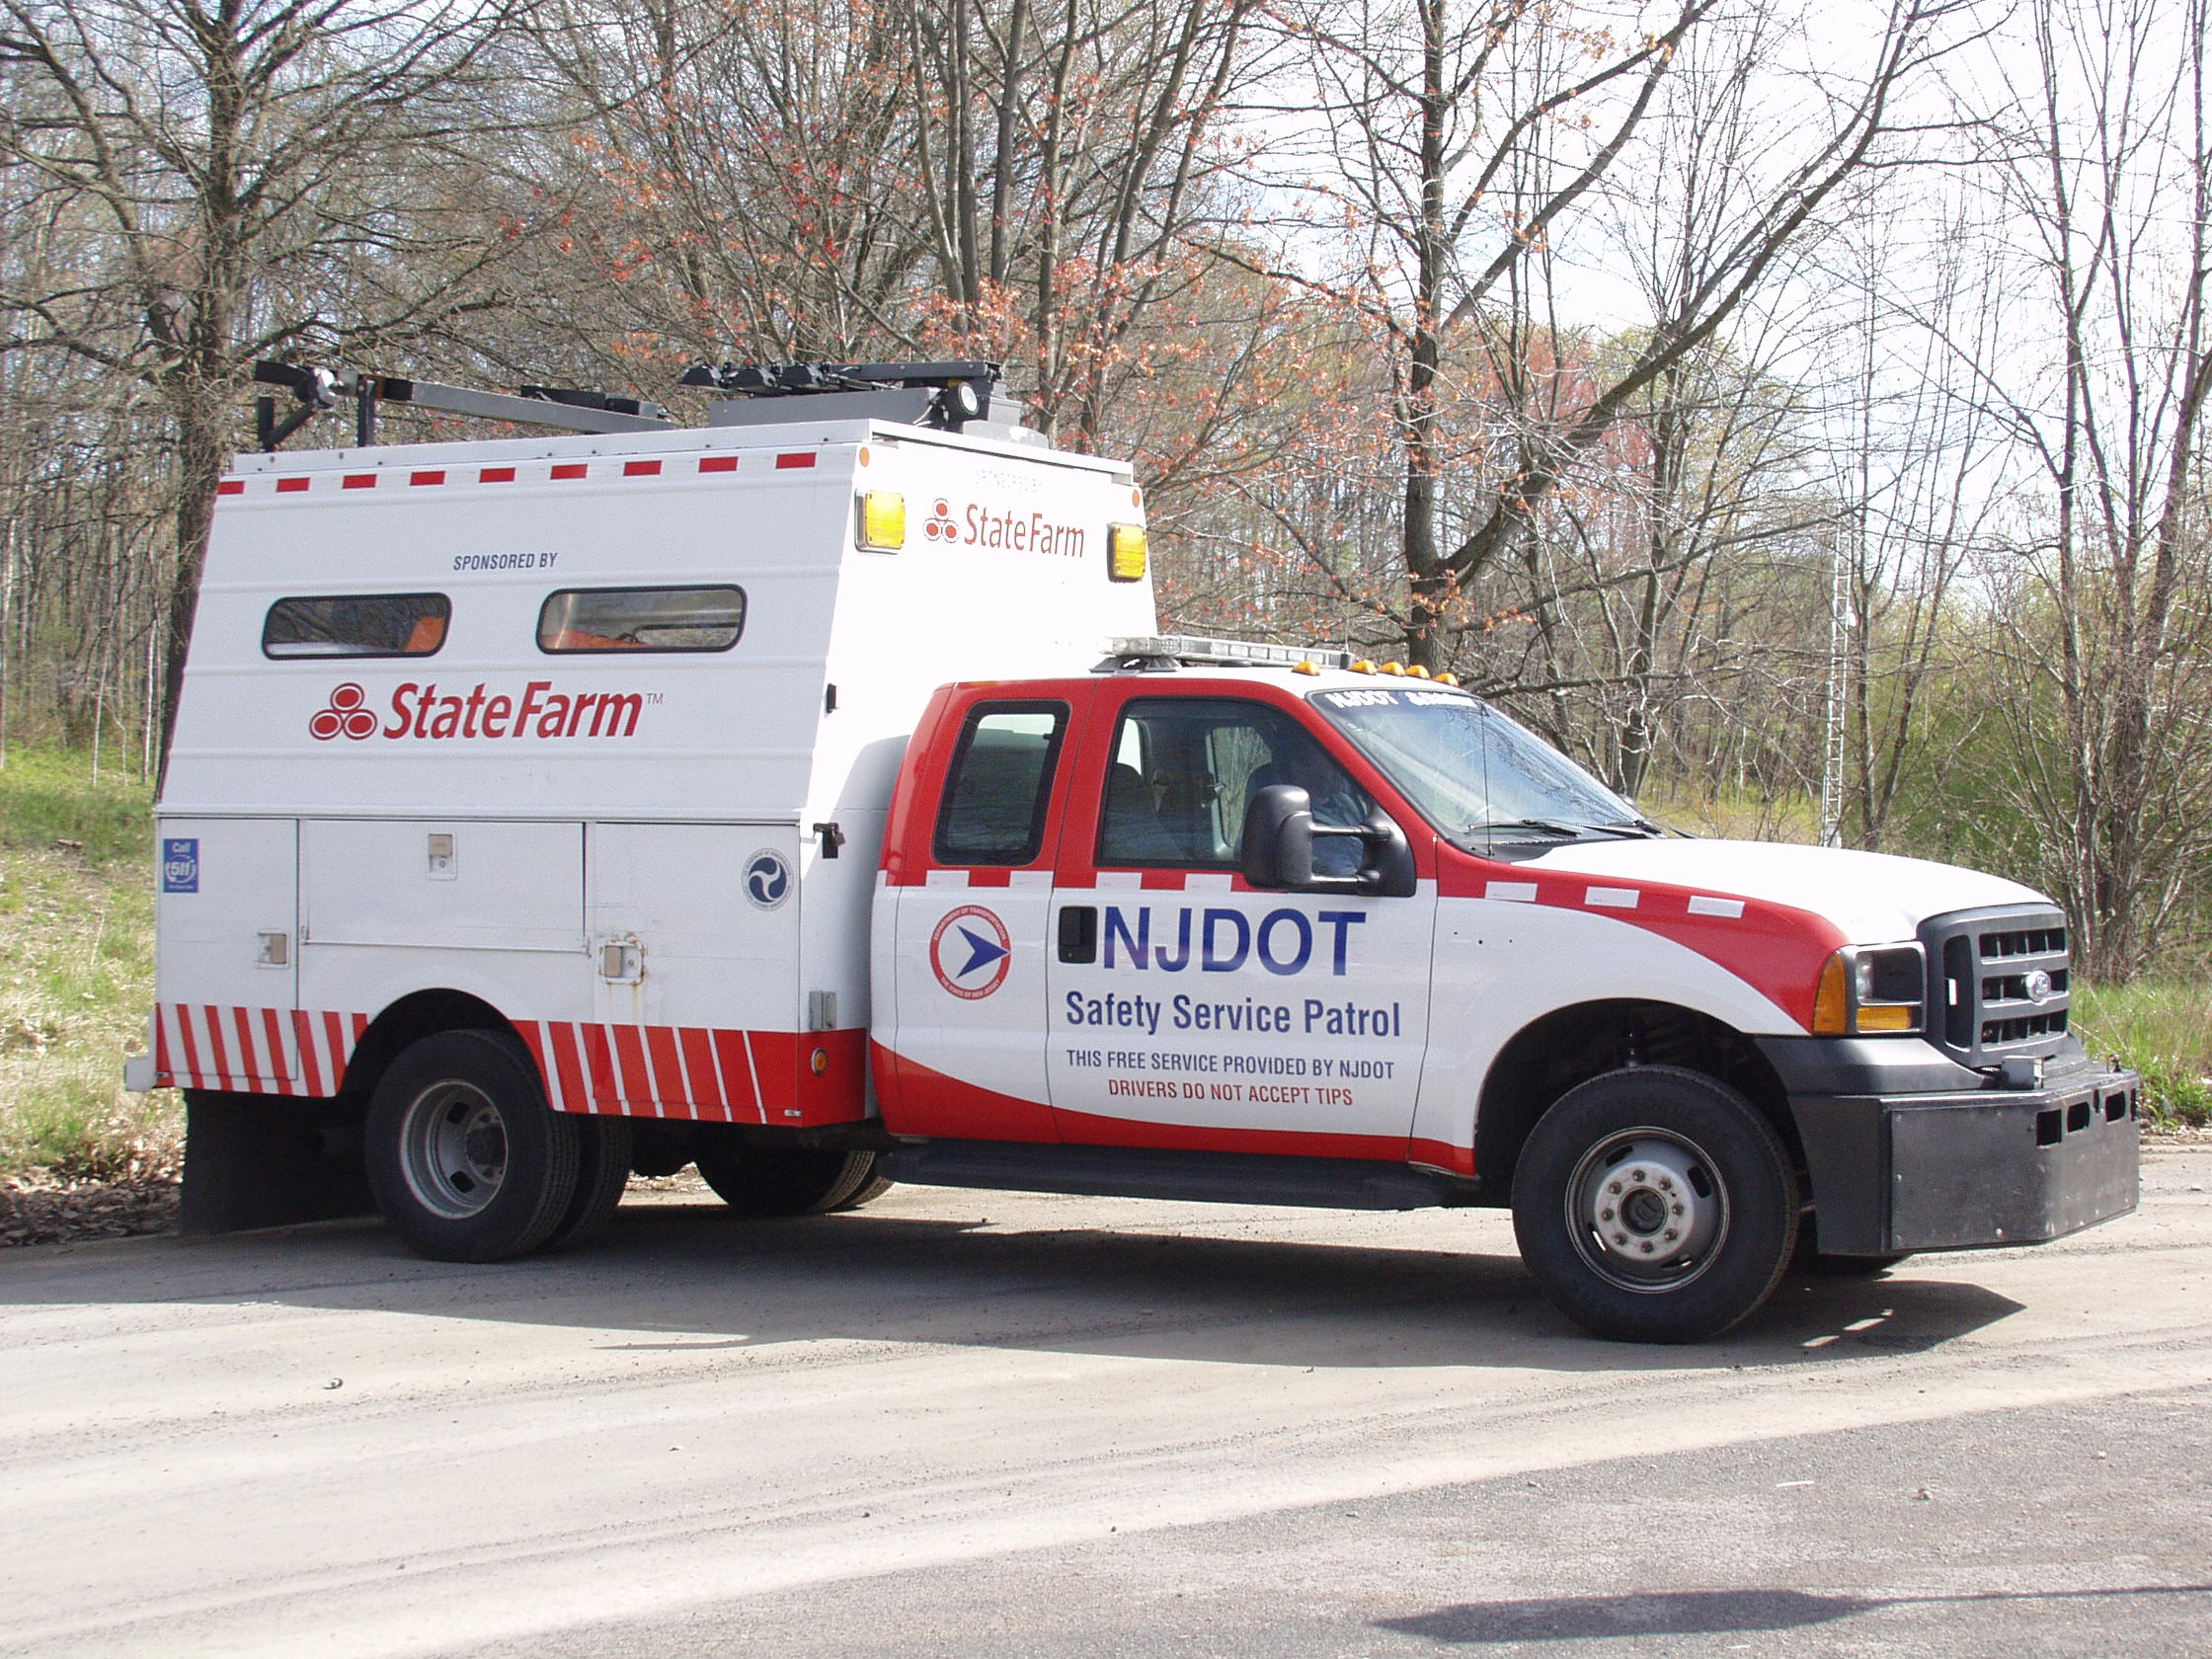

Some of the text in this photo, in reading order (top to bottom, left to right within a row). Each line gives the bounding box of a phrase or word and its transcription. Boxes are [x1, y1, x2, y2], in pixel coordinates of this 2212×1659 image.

[453, 552, 558, 571] SPONSORED BY
[1104, 906, 1367, 976] NJDOT
[1066, 990, 1400, 1037] Safety Service Patrol
[1066, 1050, 1394, 1079] THIS FREE SERVICE PROVIDED BY NJDOT
[1108, 1079, 1353, 1106] DRIVERS DO NOT ACCEPT TIPS
